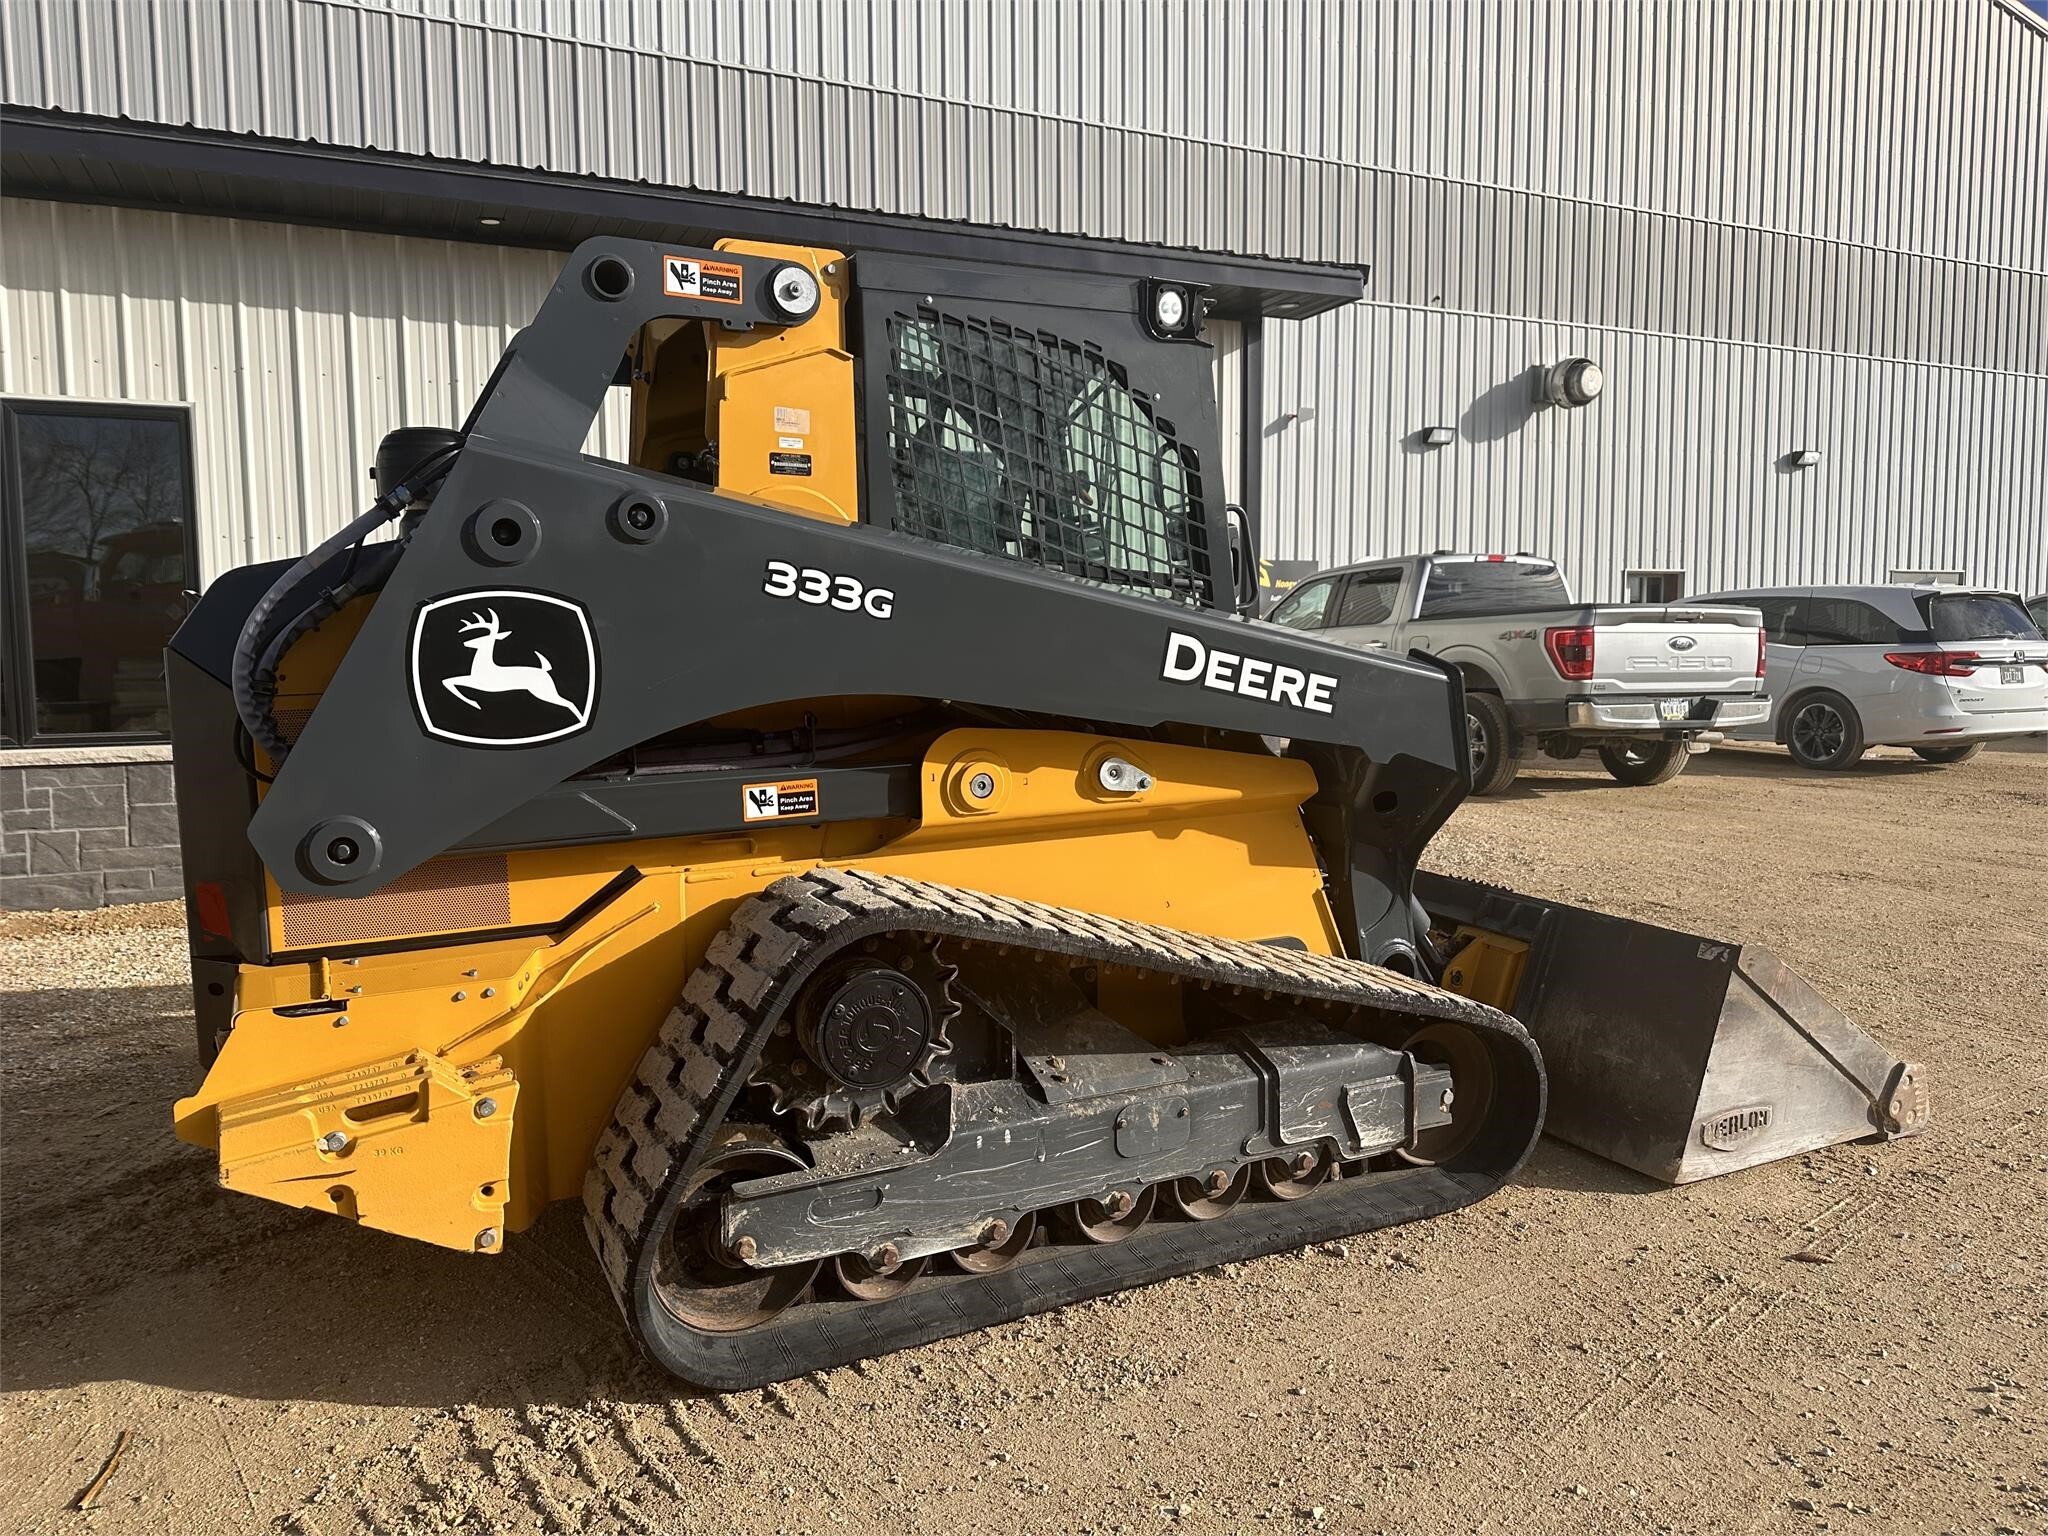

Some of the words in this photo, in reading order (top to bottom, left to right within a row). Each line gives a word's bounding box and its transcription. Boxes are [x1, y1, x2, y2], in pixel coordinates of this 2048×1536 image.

[709, 264, 738, 275] WARNING
[702, 277, 721, 287] Pinch
[722, 279, 738, 289] Area
[702, 286, 716, 295] Keep
[717, 288, 733, 297] Away
[764, 561, 894, 619] 333G
[1625, 656, 1734, 671] F-150
[1162, 631, 1338, 714] DEERE
[786, 782, 814, 791] WARNING
[780, 796, 798, 804] Pinch
[318, 1103, 337, 1115] USA
[388, 1145, 404, 1156] KG
